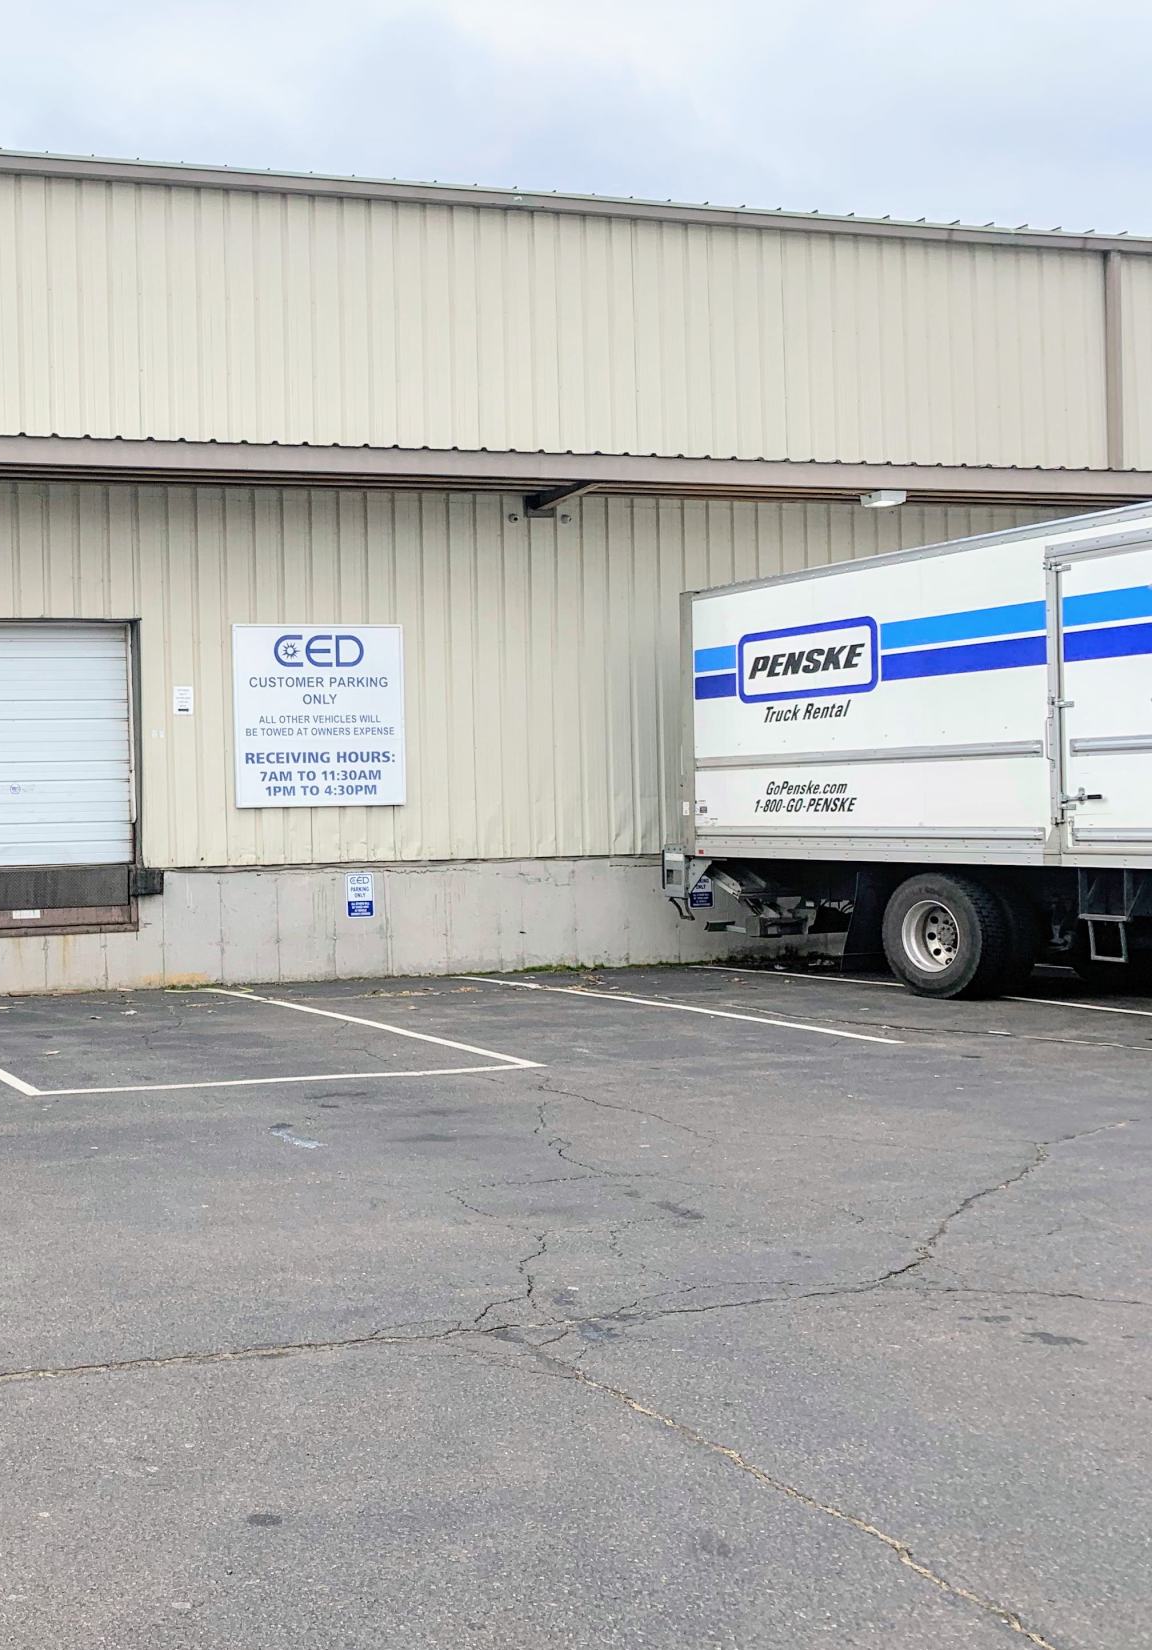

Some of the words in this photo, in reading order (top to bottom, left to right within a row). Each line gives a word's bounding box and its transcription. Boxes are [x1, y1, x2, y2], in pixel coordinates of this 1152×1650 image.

[274, 635, 364, 667] CED
[748, 643, 865, 680] PENSKE
[249, 676, 324, 688] CUSTOMER
[329, 676, 388, 688] PARKING
[302, 693, 337, 705] ONLY
[764, 704, 800, 723] Truck
[802, 699, 851, 720] Rental
[259, 715, 277, 724] ALL
[279, 715, 310, 724] OTHER
[313, 715, 357, 723] VEHICLES
[359, 715, 381, 723] WILL
[245, 728, 258, 736] BE
[261, 728, 294, 736] TOWED
[296, 728, 309, 736] AT
[311, 727, 351, 735] OWNERS
[353, 727, 395, 735] EXPENSE
[245, 752, 330, 764] RECEIVING
[336, 751, 396, 763] HOURS:
[260, 771, 293, 782] 7AM
[297, 771, 316, 781] TO
[321, 770, 382, 780] 11:30AM
[265, 786, 296, 797] 1PM
[301, 786, 320, 796] TO
[324, 785, 377, 796] 4:30PM
[766, 780, 848, 795] GoPenske.com
[754, 797, 857, 813] 1-800-GO-PENSKE
